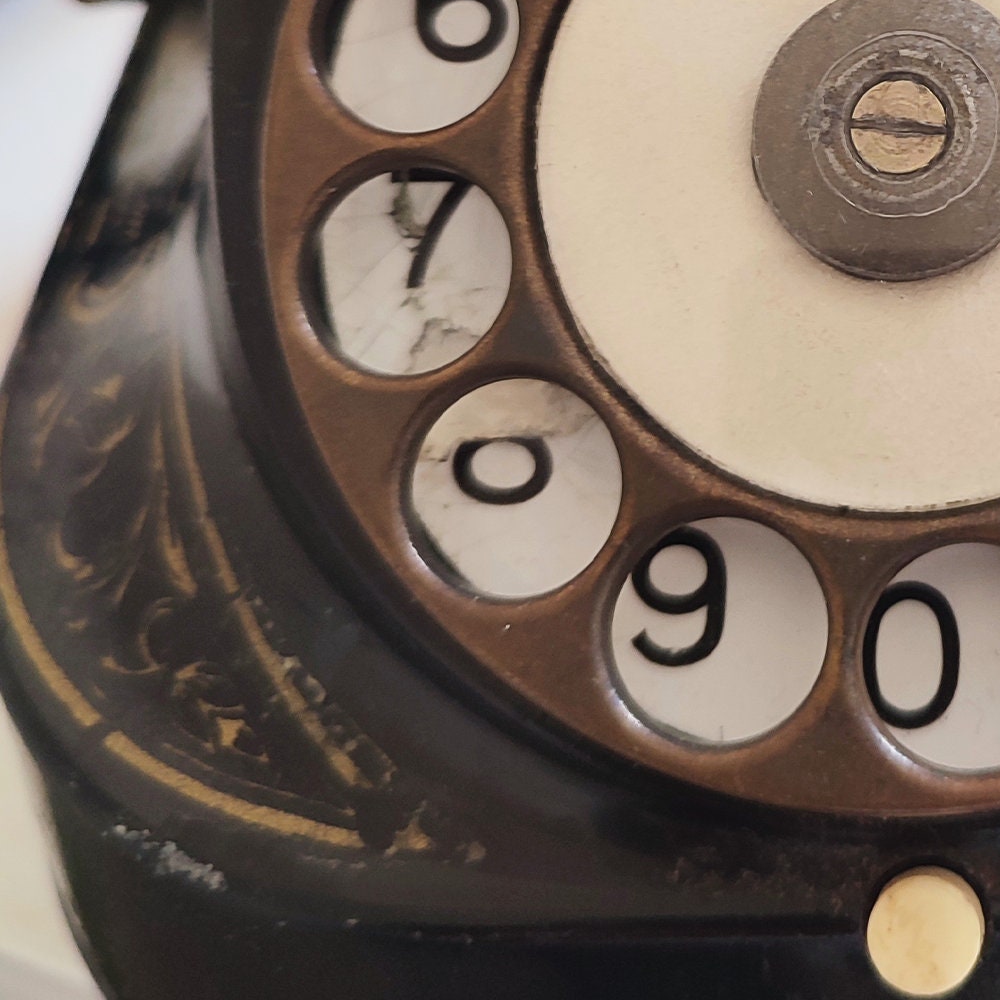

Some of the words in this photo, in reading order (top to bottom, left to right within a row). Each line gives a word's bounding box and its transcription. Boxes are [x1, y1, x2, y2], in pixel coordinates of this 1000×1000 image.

[391, 167, 472, 289] 7
[631, 525, 727, 667] 9
[862, 580, 960, 729] 0
